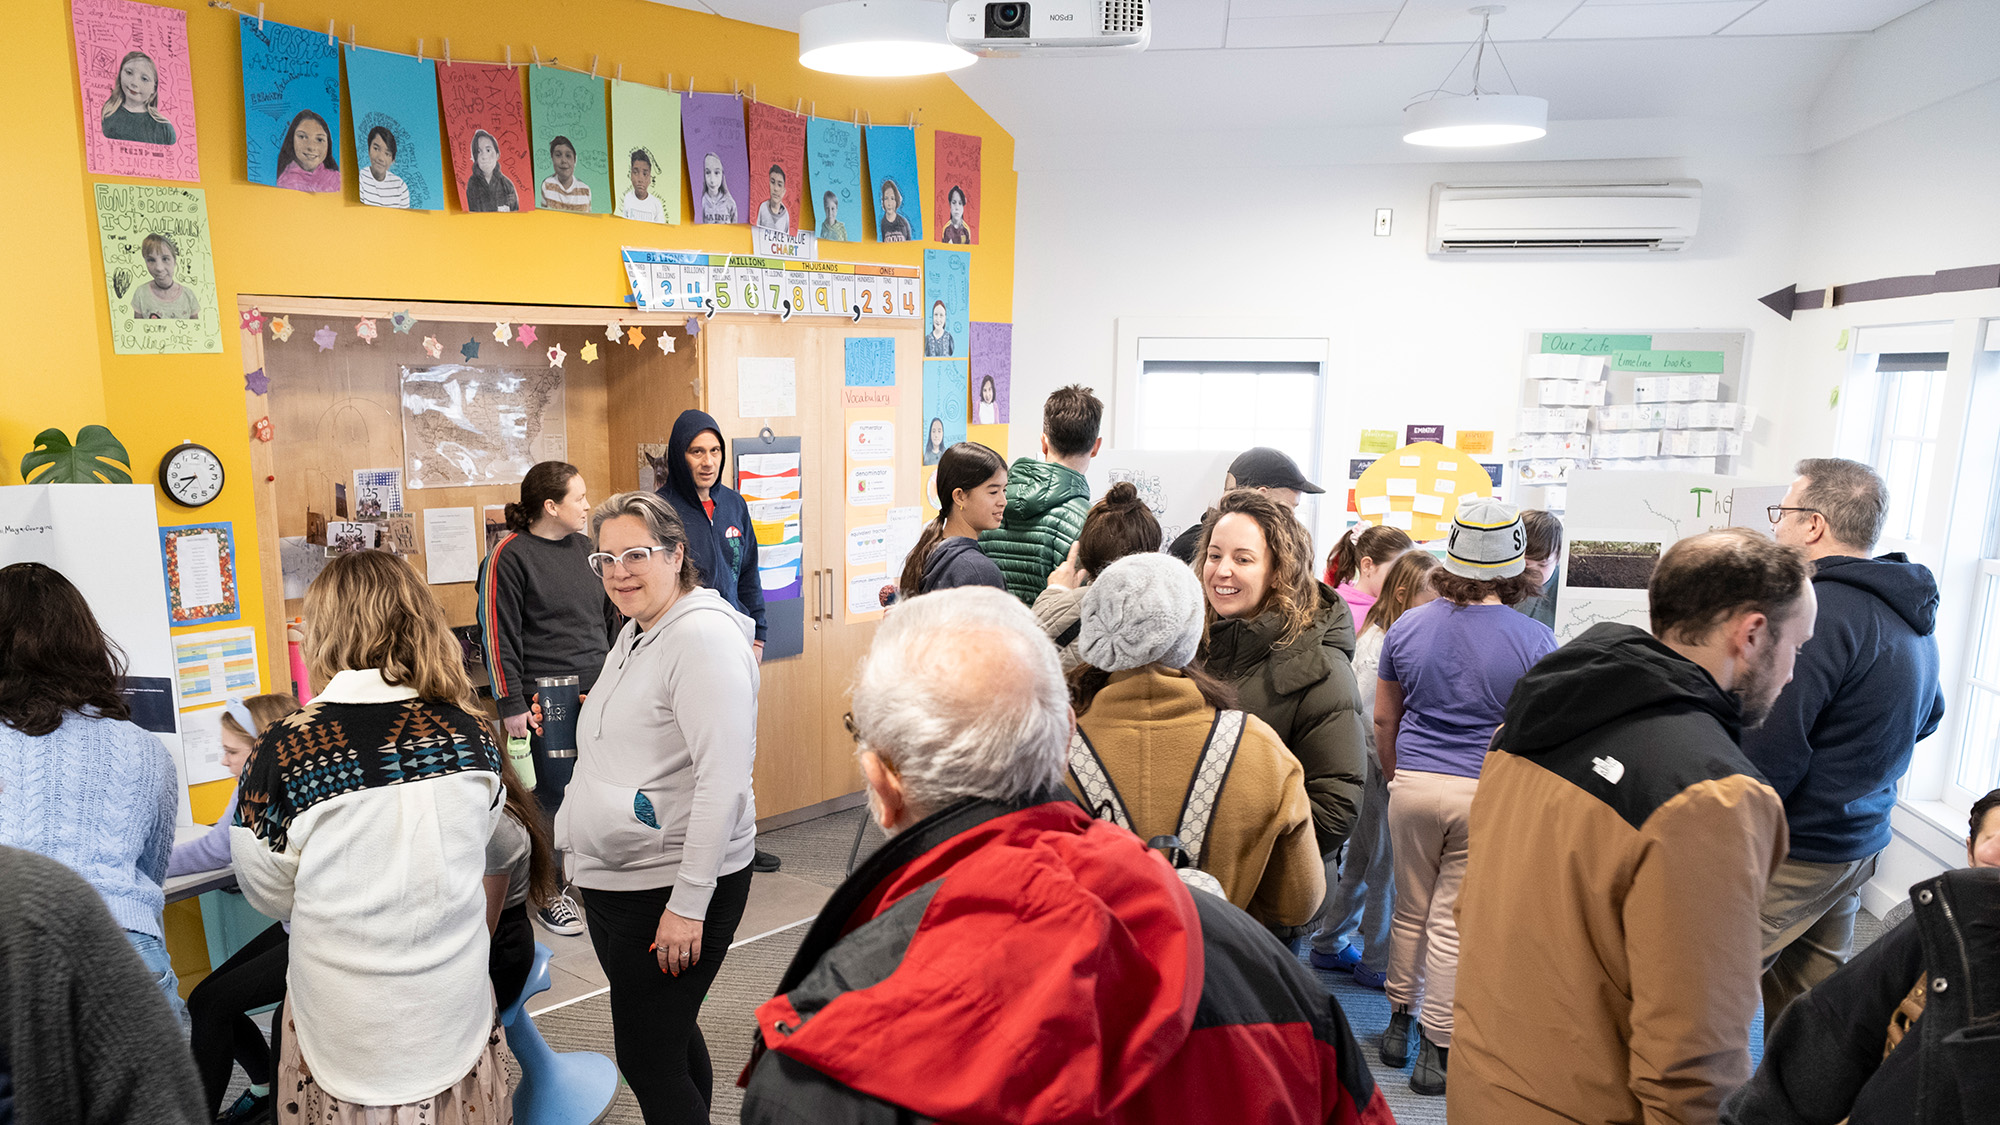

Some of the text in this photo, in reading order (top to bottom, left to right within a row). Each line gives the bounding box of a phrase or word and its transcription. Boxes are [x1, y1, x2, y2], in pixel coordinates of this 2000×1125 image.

[119, 157, 165, 171] SINGER
[96, 184, 128, 212] FUN
[156, 186, 179, 196] BOBA
[147, 199, 183, 214] BLONDE
[139, 216, 199, 237] ANIMALS
[764, 230, 806, 245] PLACE VALUE
[771, 243, 799, 256] CHART
[683, 266, 705, 274] BILLIONS
[729, 258, 766, 267] MILLIONS
[802, 262, 838, 272] THOUSANDS
[879, 267, 895, 275] ONES
[715, 282, 731, 308] 5
[744, 283, 759, 308] 6
[793, 286, 804, 312] 8
[815, 287, 829, 312] 9
[861, 289, 873, 314] 2
[882, 290, 893, 315] 3
[903, 291, 914, 315] 4
[1550, 335, 1610, 351] Our Life
[1617, 353, 1692, 368] timeline books
[845, 390, 891, 405] Vocabulary
[211, 473, 218, 481] 3
[191, 492, 198, 500] 6
[362, 487, 379, 500] 125
[1689, 487, 1733, 518] The
[341, 523, 363, 537] 125
[545, 706, 567, 715] ULOS
[547, 714, 567, 723] PANY
